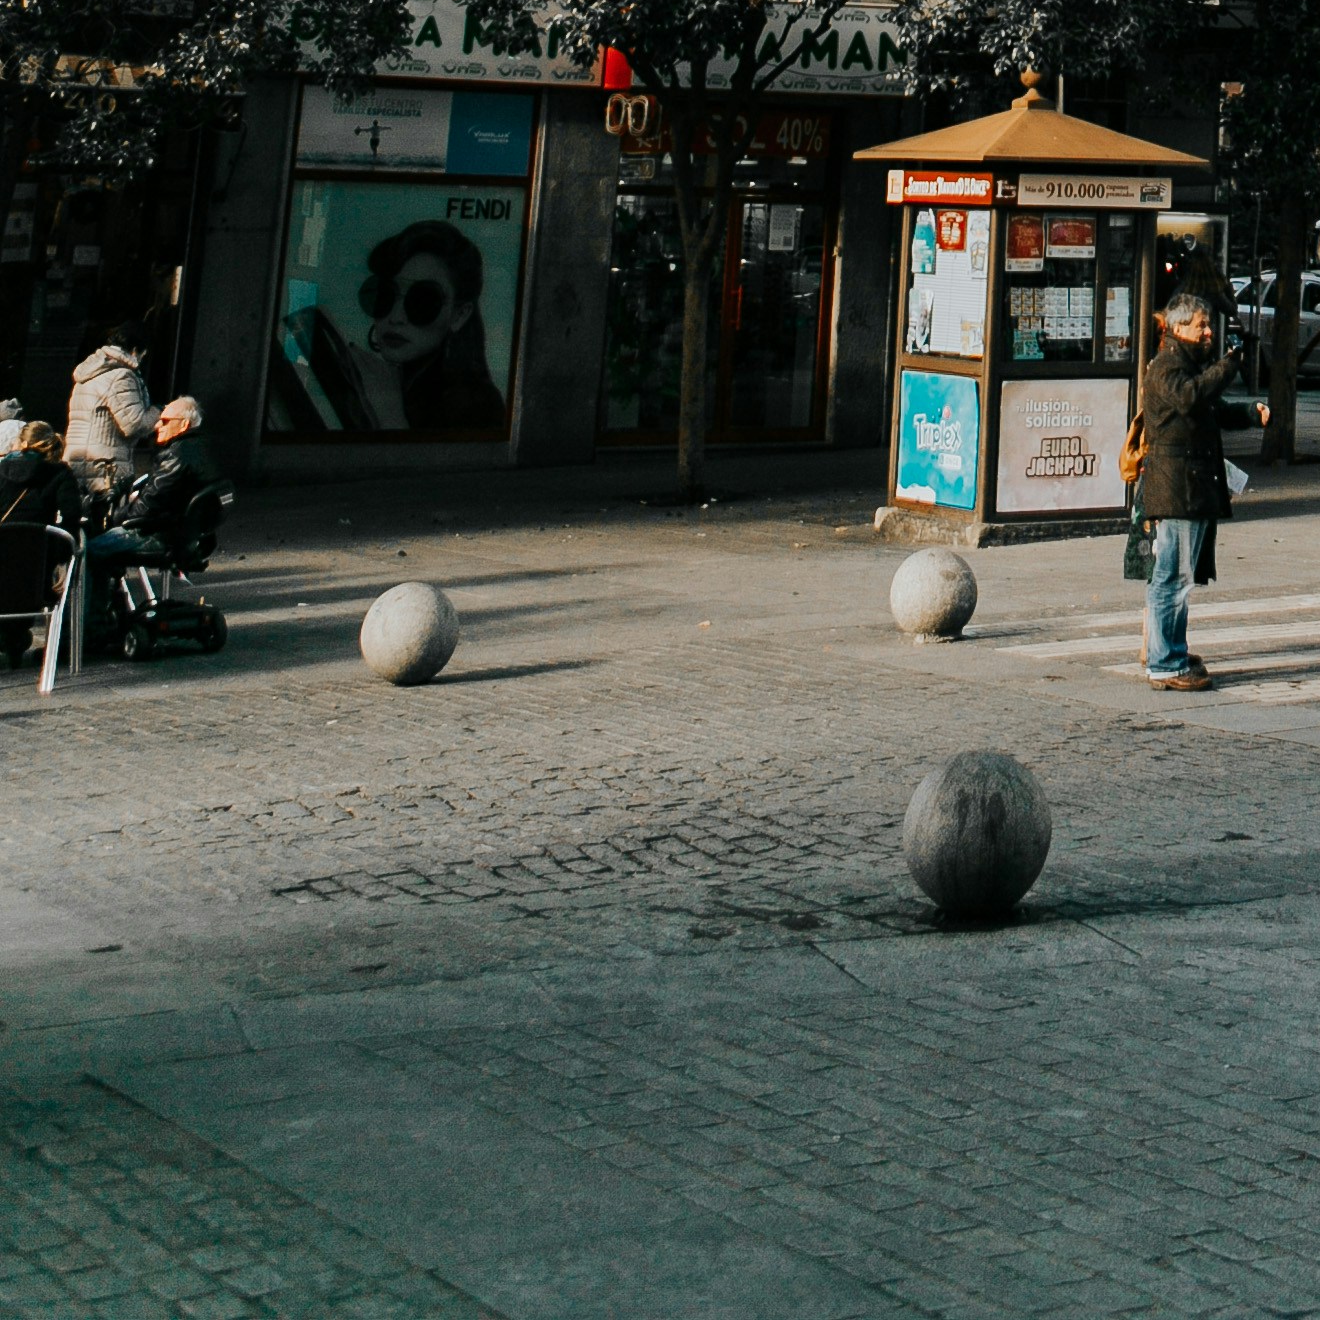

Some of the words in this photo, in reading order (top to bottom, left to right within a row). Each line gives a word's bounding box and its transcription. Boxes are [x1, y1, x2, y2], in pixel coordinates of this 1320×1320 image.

[776, 117, 823, 152] 40%
[1046, 182, 1105, 199] 910.000
[446, 197, 511, 220] FENDI
[1025, 398, 1070, 413] ilusión
[1025, 411, 1093, 429] solidaria
[913, 413, 962, 452] Triplex
[1041, 436, 1081, 457] EURO
[1025, 454, 1096, 477] JACKPOT
